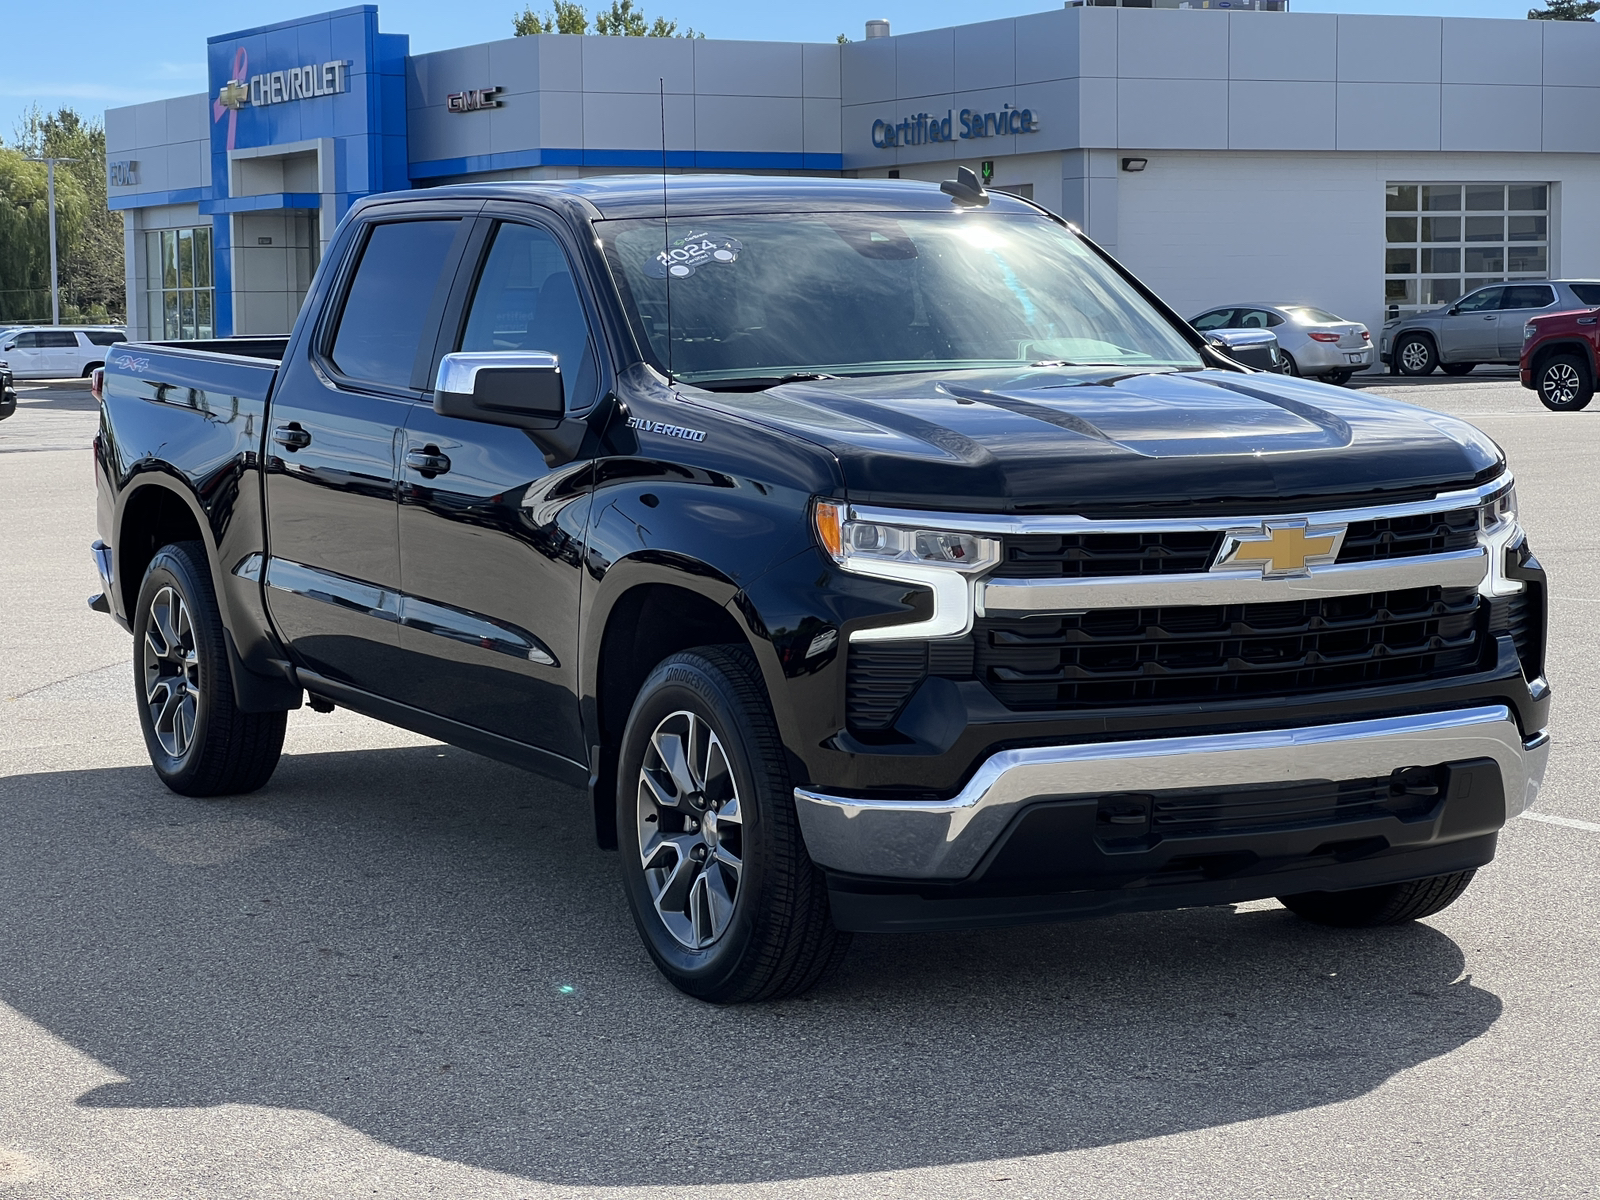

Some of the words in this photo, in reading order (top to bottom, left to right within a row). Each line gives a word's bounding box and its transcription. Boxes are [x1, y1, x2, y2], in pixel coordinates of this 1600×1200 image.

[250, 59, 348, 107] CHEVROLET
[447, 86, 498, 113] GMC
[871, 108, 954, 149] Certified
[959, 103, 1035, 140] Service
[109, 160, 134, 186] FOX
[656, 239, 717, 267] 2024
[625, 416, 707, 443] SILVERADO
[665, 667, 721, 711] BRIDGESTONE
